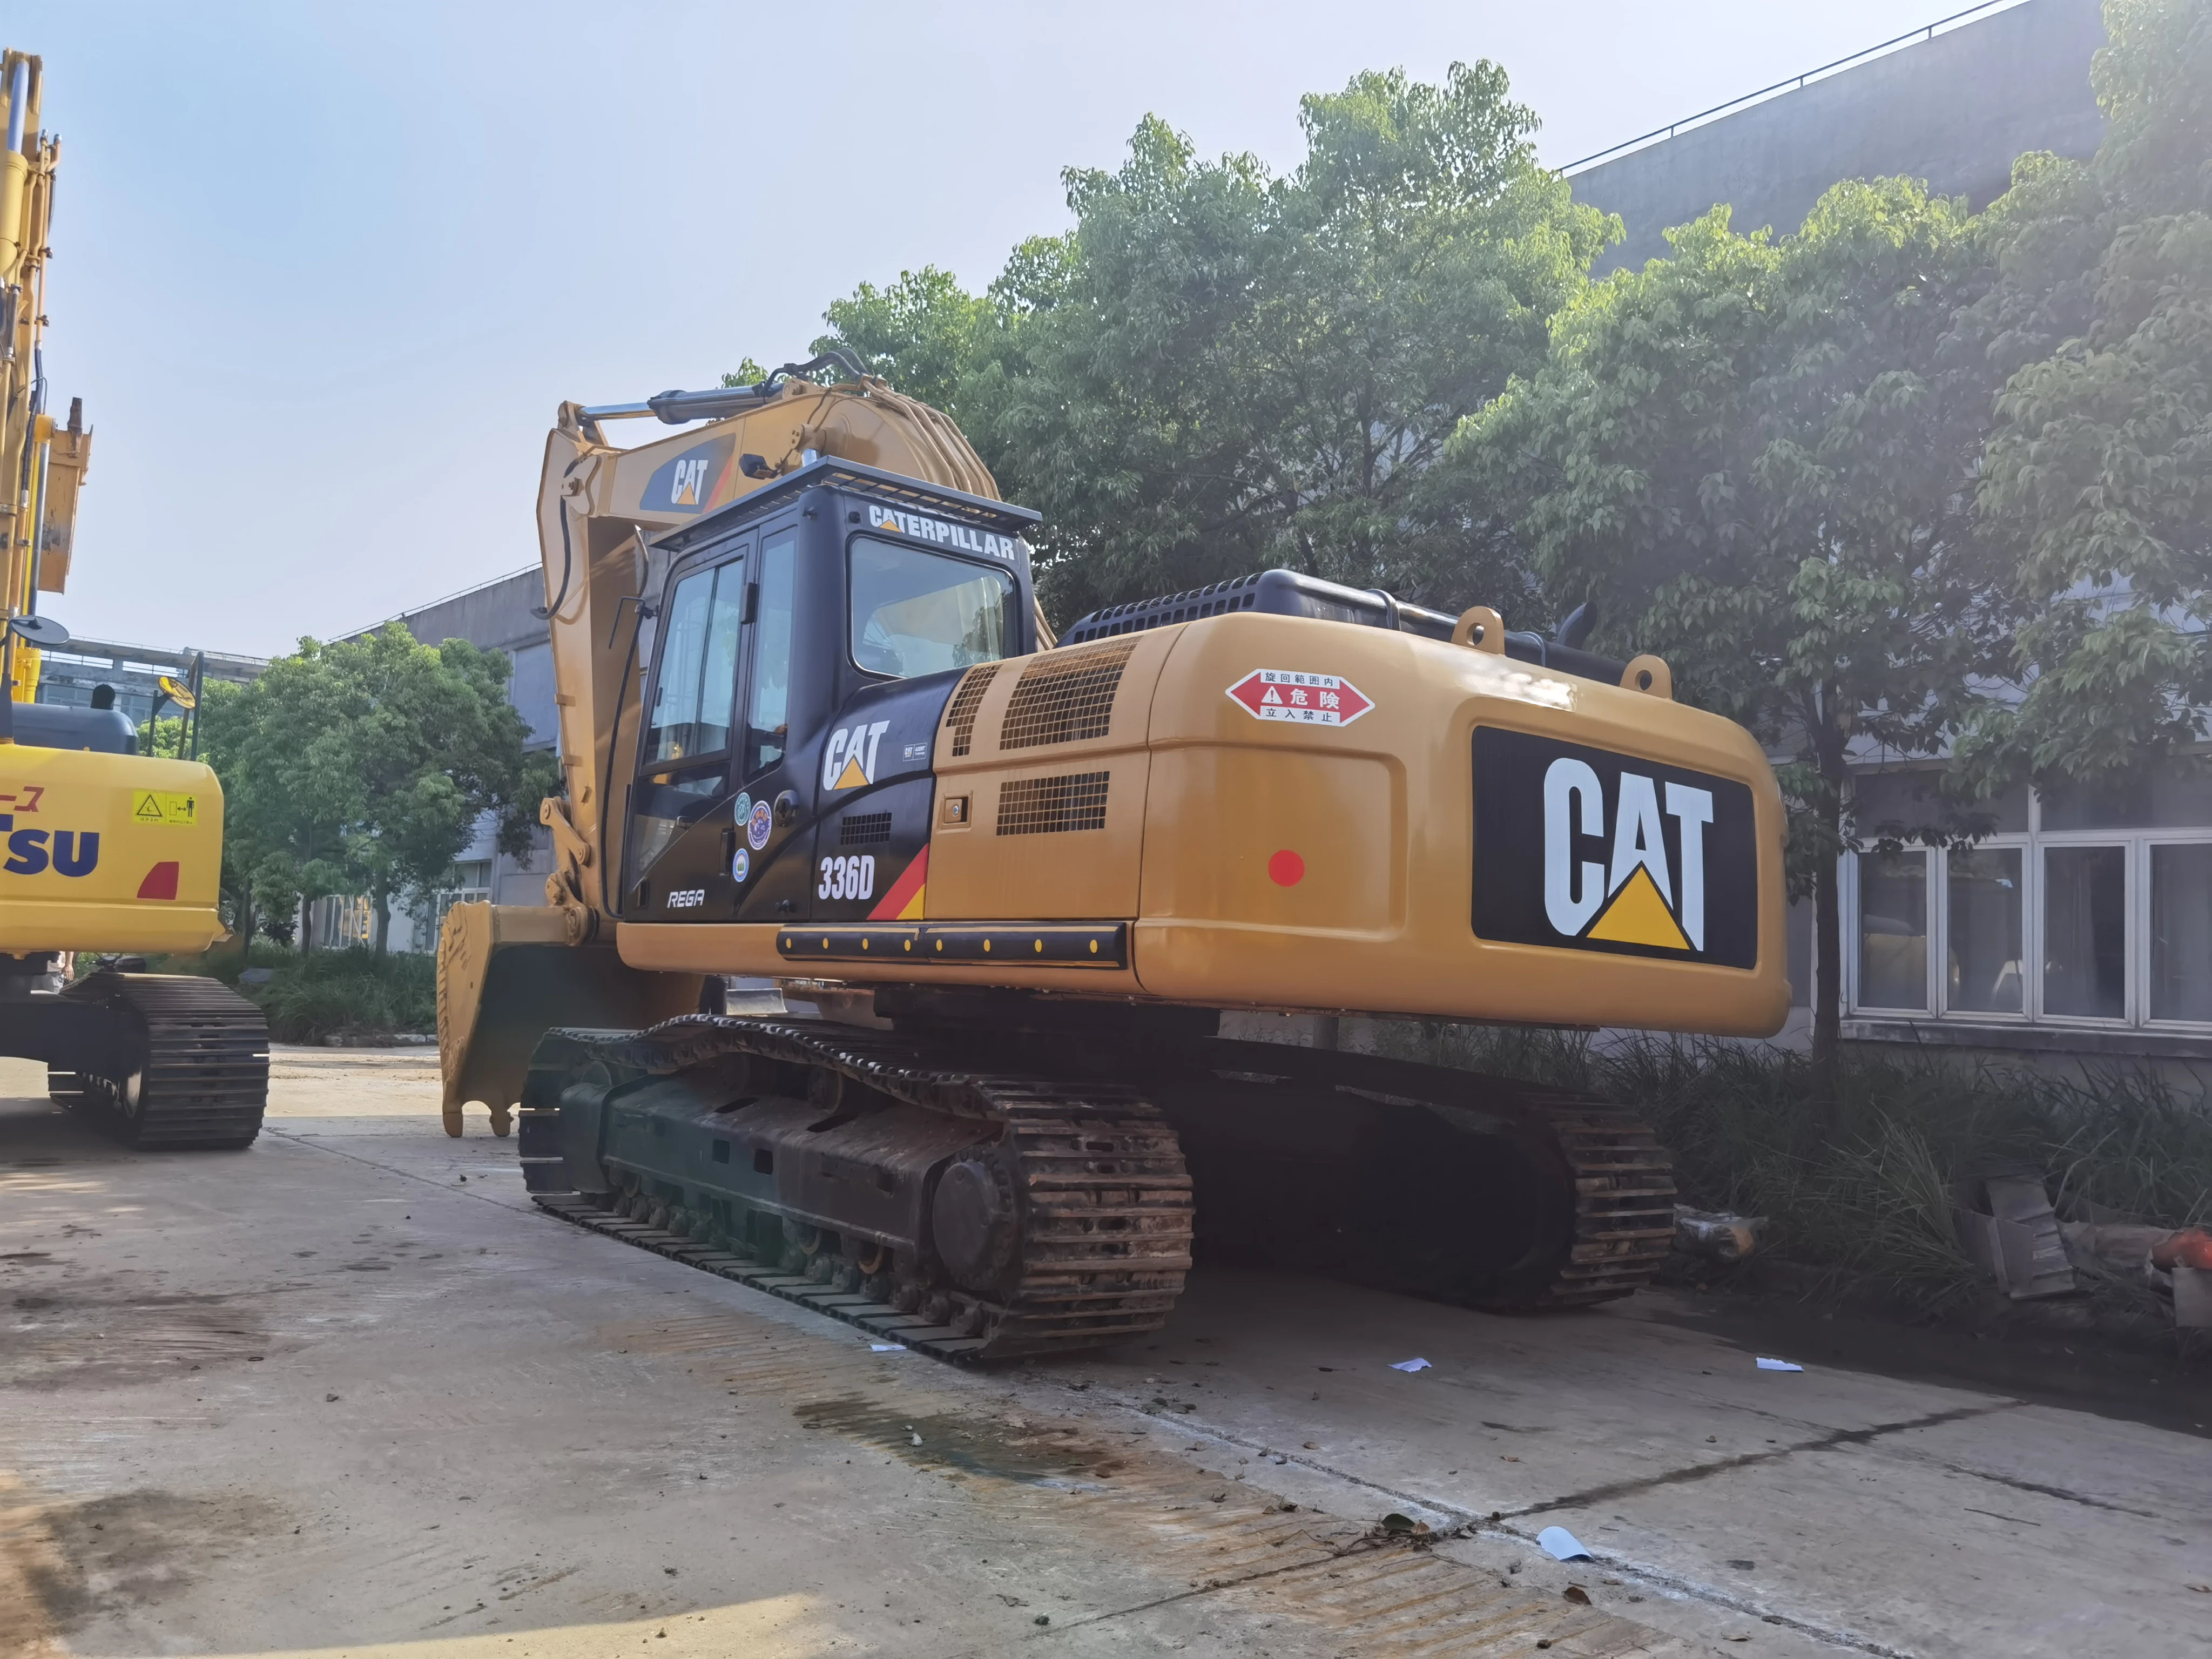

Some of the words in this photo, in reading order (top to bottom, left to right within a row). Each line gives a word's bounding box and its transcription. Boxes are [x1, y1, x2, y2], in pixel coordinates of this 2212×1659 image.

[671, 460, 709, 505] CAT
[869, 505, 1015, 561] CATERPILLAR
[1265, 672, 1333, 686] 旋回範囲内
[1266, 708, 1332, 722] 立入禁止
[1290, 688, 1340, 710] 危険
[823, 720, 890, 791] CAT
[905, 747, 913, 755] CAT
[1544, 757, 1714, 952] CAT
[818, 855, 875, 900] 336D
[667, 889, 705, 908] REGA
